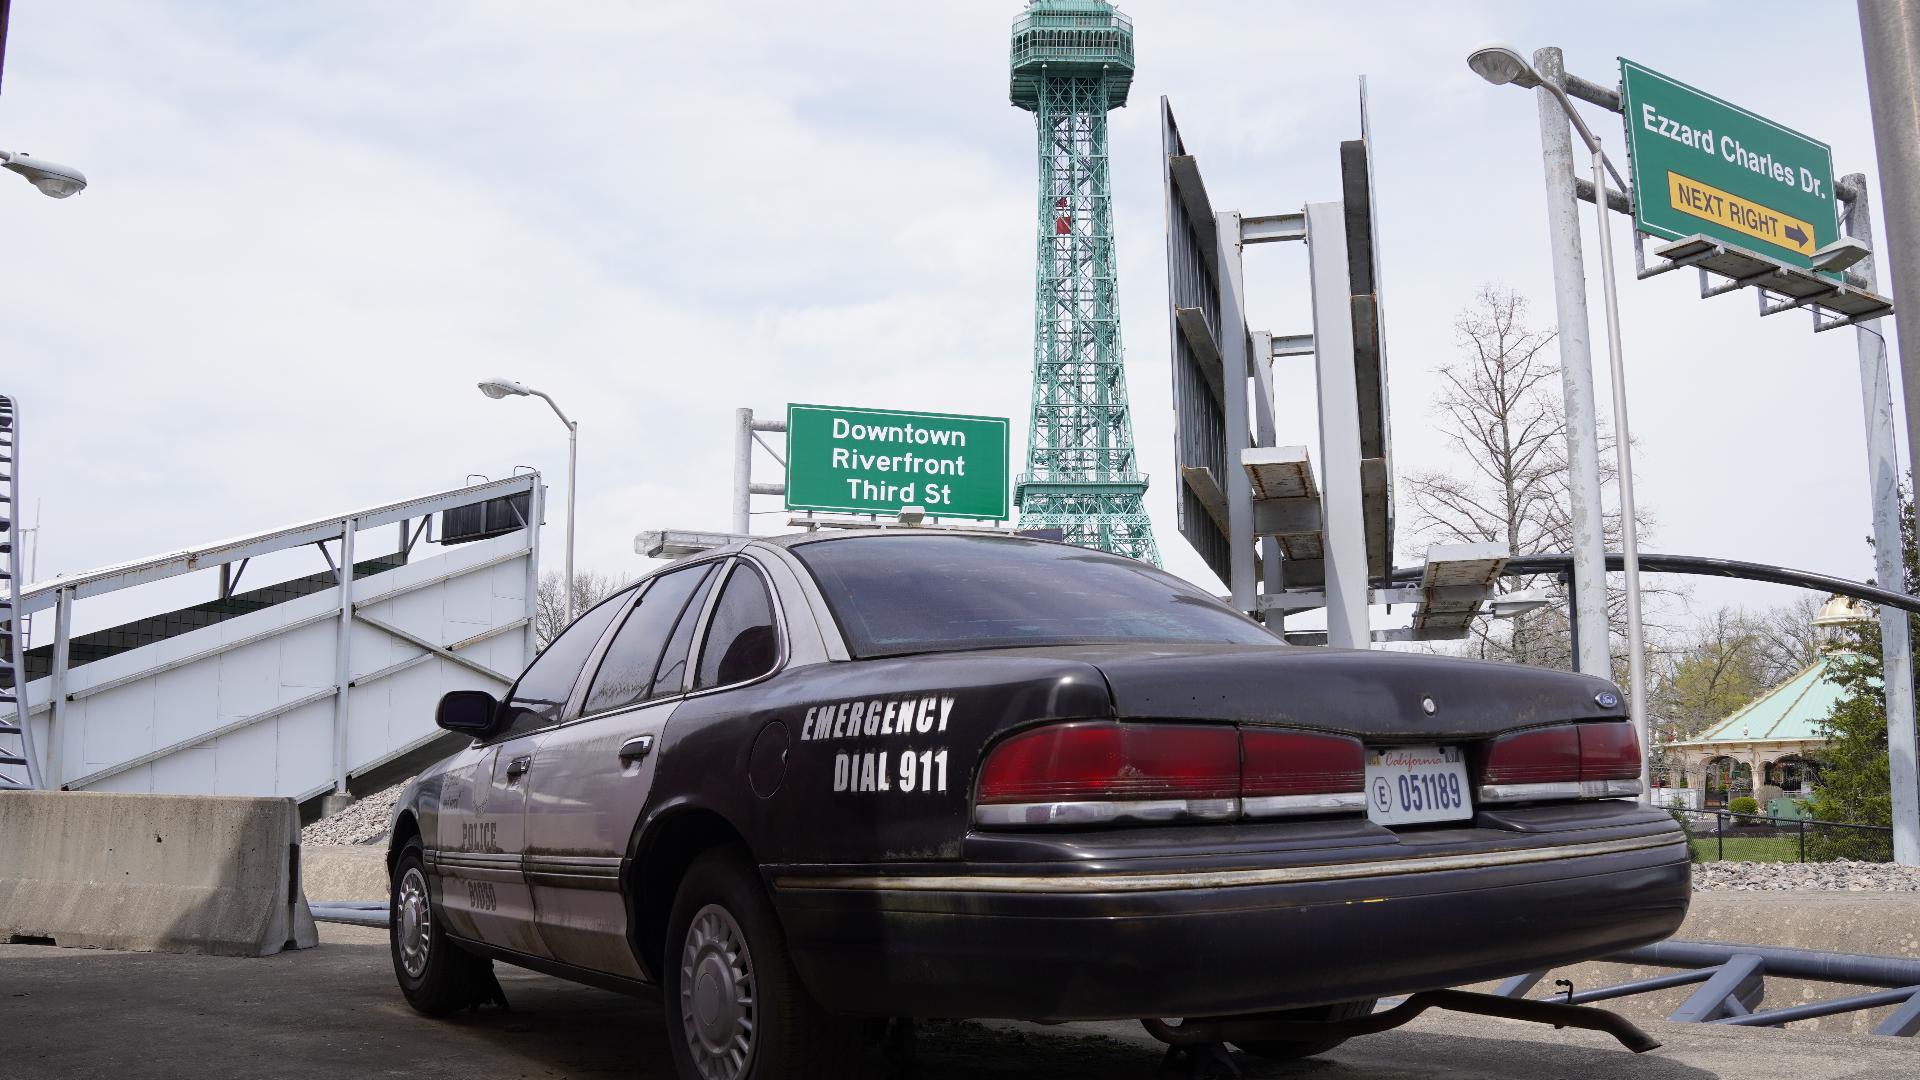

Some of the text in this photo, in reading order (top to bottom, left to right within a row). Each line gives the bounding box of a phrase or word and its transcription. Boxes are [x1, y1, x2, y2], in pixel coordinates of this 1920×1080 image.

[1642, 102, 1826, 199] Ezzard Charles Dr.
[1677, 181, 1778, 238] NEXT RIGHT
[832, 417, 966, 447] Downtown
[832, 447, 965, 476] Riverfront
[846, 478, 951, 505] Third St
[801, 697, 954, 740] EMERGENCY
[833, 750, 948, 792] DIAL 911
[1385, 752, 1441, 773] California
[1378, 772, 1461, 812] E 051189
[462, 822, 497, 852] POLICE
